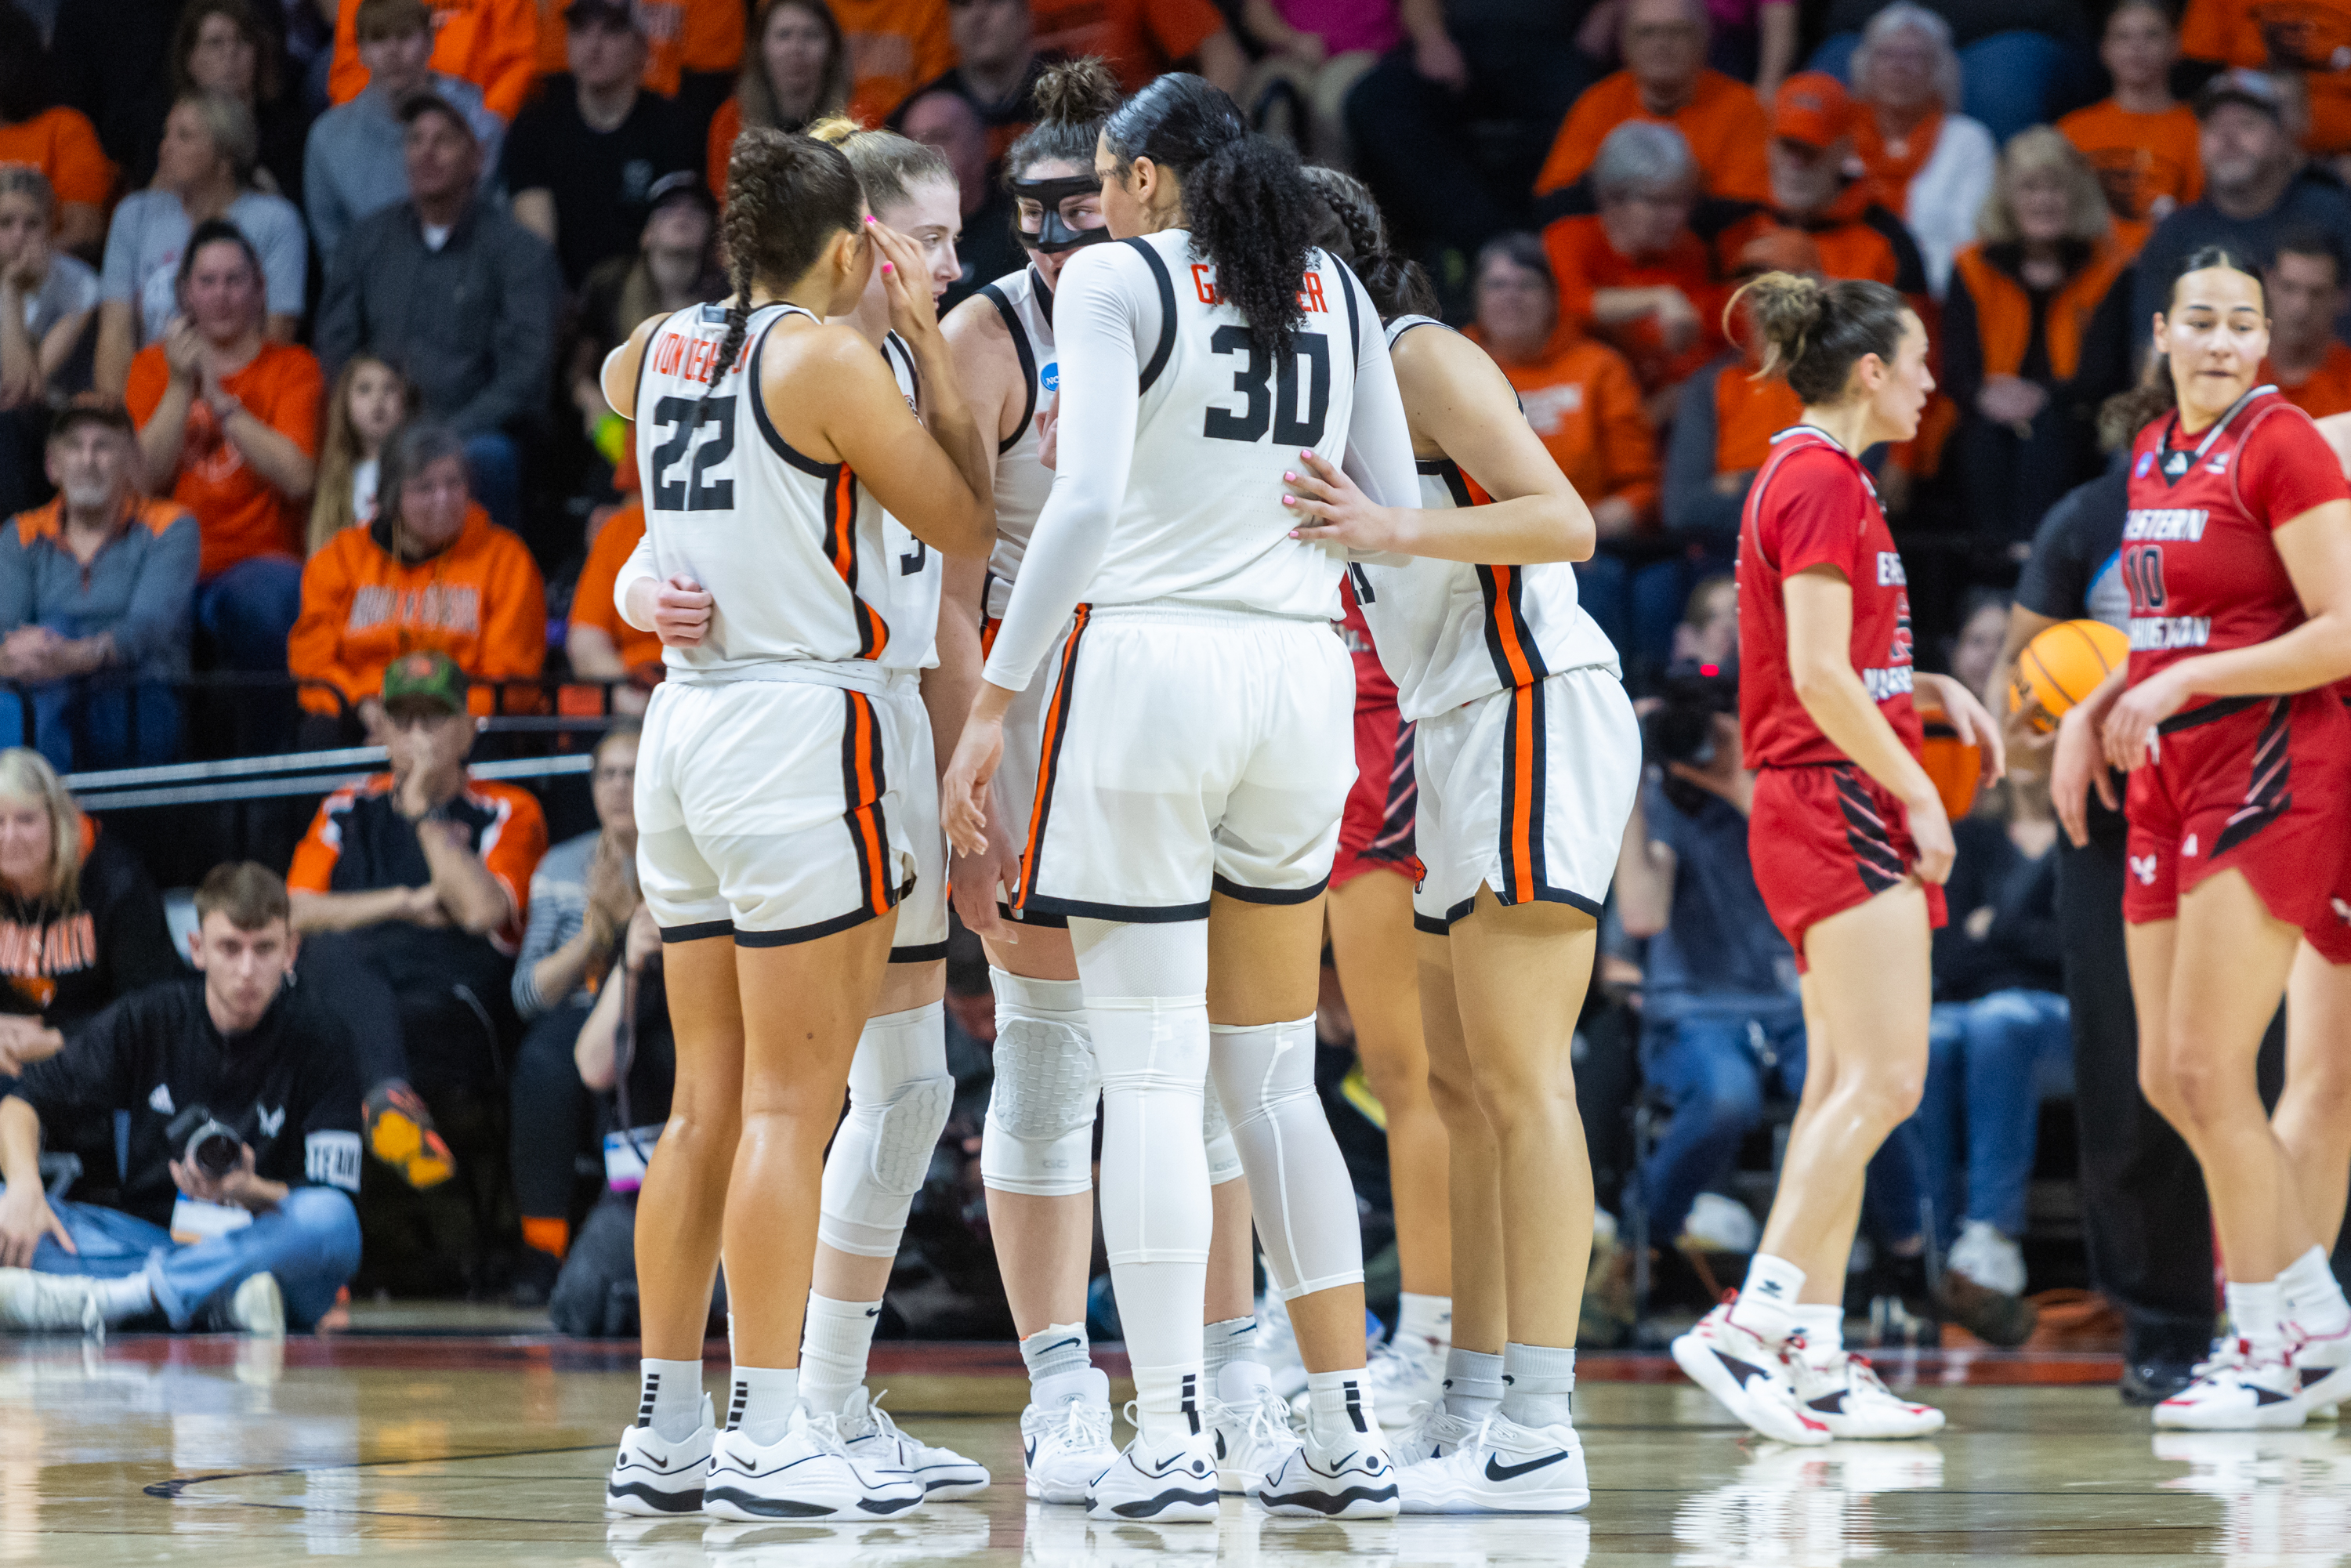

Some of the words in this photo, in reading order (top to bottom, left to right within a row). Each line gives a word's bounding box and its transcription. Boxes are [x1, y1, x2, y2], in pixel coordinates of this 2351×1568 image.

[652, 331, 686, 376] VON
[1045, 375, 1059, 385] NC
[1203, 324, 1331, 447] 30
[652, 395, 737, 511] 22
[2125, 545, 2168, 613] 10
